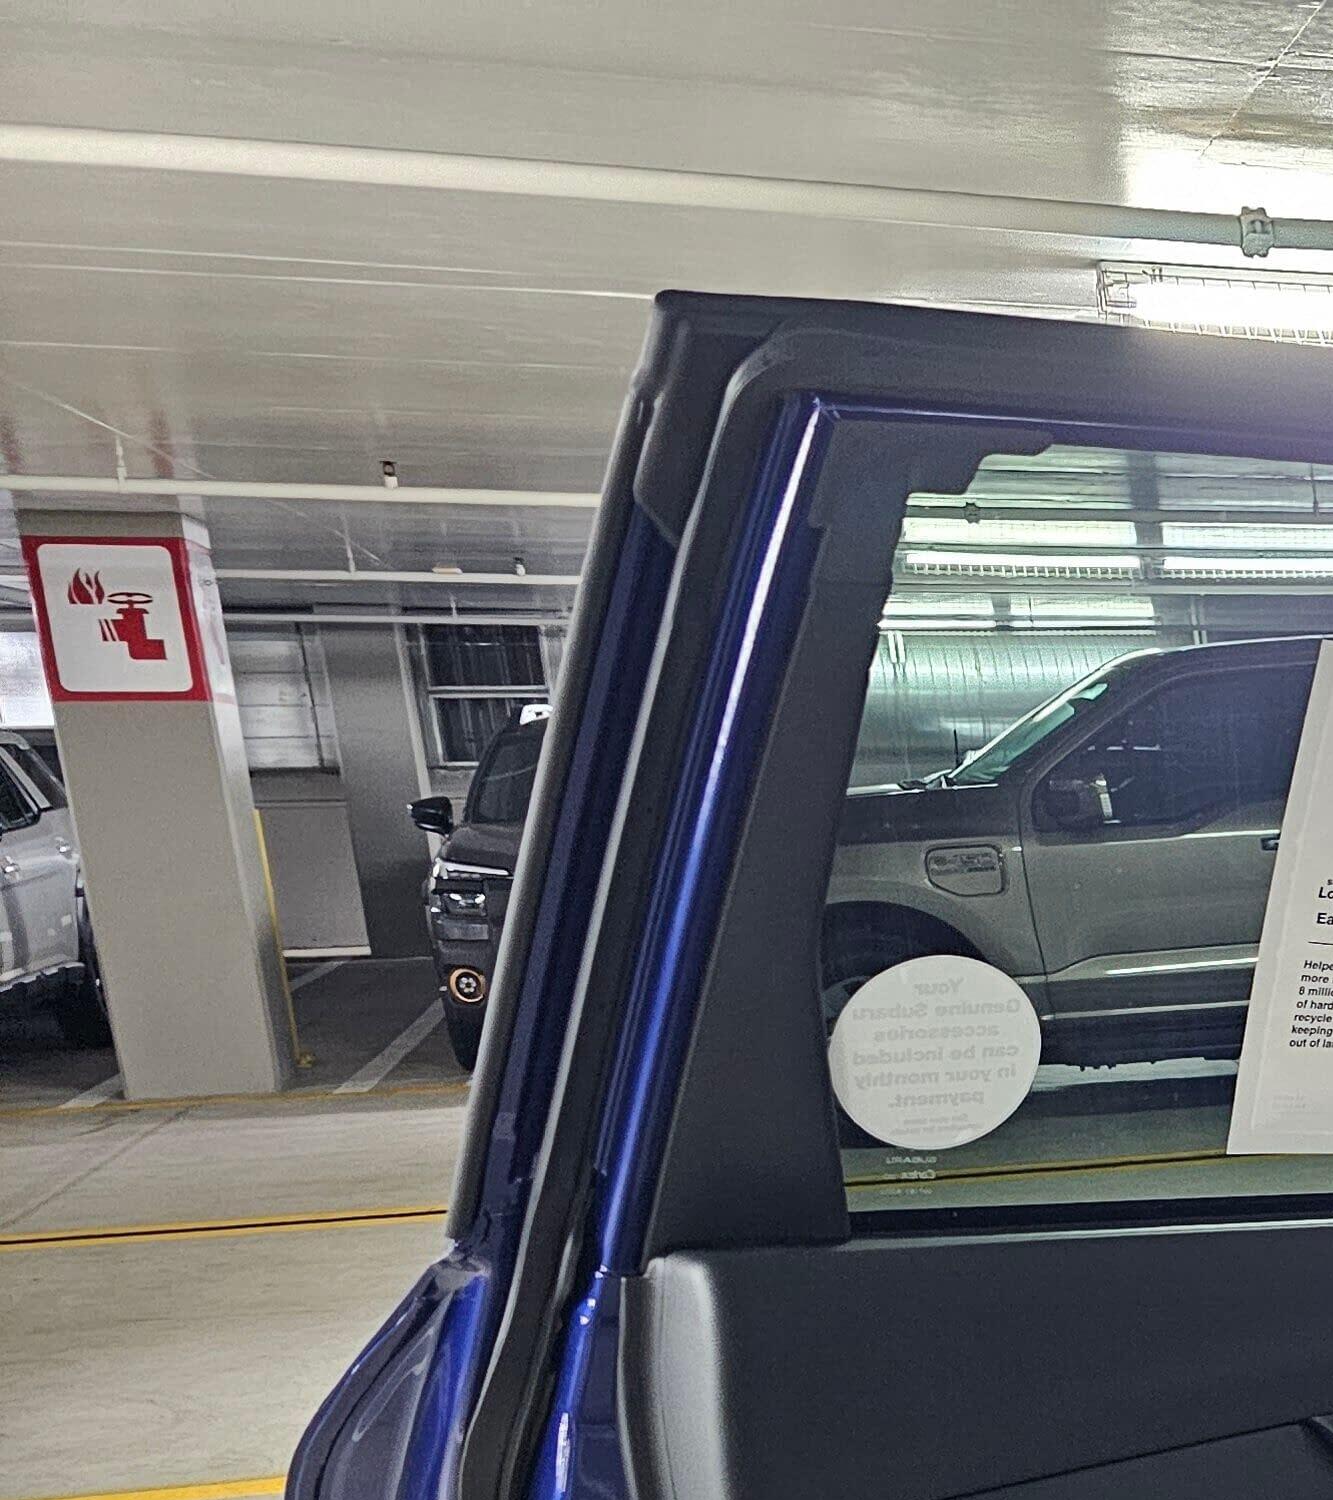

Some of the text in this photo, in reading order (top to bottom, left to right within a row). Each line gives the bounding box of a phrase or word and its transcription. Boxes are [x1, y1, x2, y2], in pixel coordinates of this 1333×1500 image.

[1301, 975, 1329, 983] more
[1299, 986, 1305, 995] 8
[1296, 1000, 1308, 1008] of
[1294, 1014, 1332, 1024] recycle
[1291, 1025, 1333, 1037] keeping
[1289, 1039, 1307, 1047] out
[1309, 1039, 1320, 1047] of
